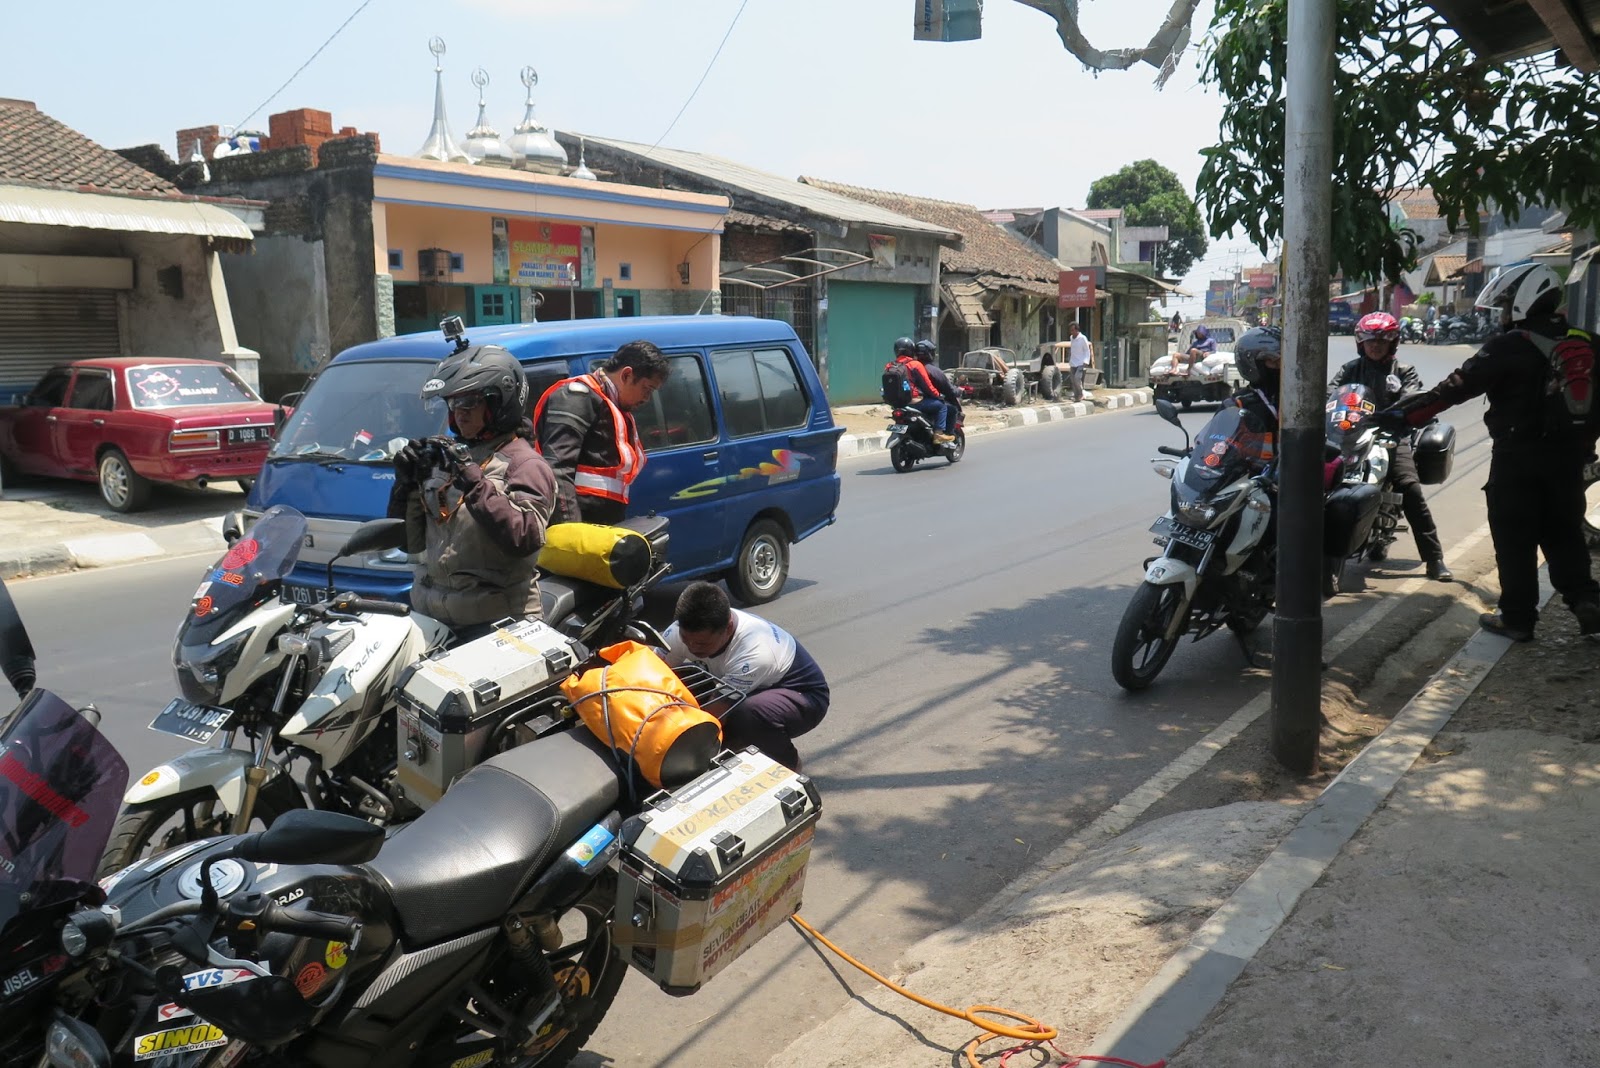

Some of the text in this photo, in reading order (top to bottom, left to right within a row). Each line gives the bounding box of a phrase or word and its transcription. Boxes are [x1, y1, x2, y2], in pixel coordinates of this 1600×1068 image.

[291, 586, 312, 604] 1261
[185, 970, 224, 989] TVS
[163, 1047, 174, 1055] OF
